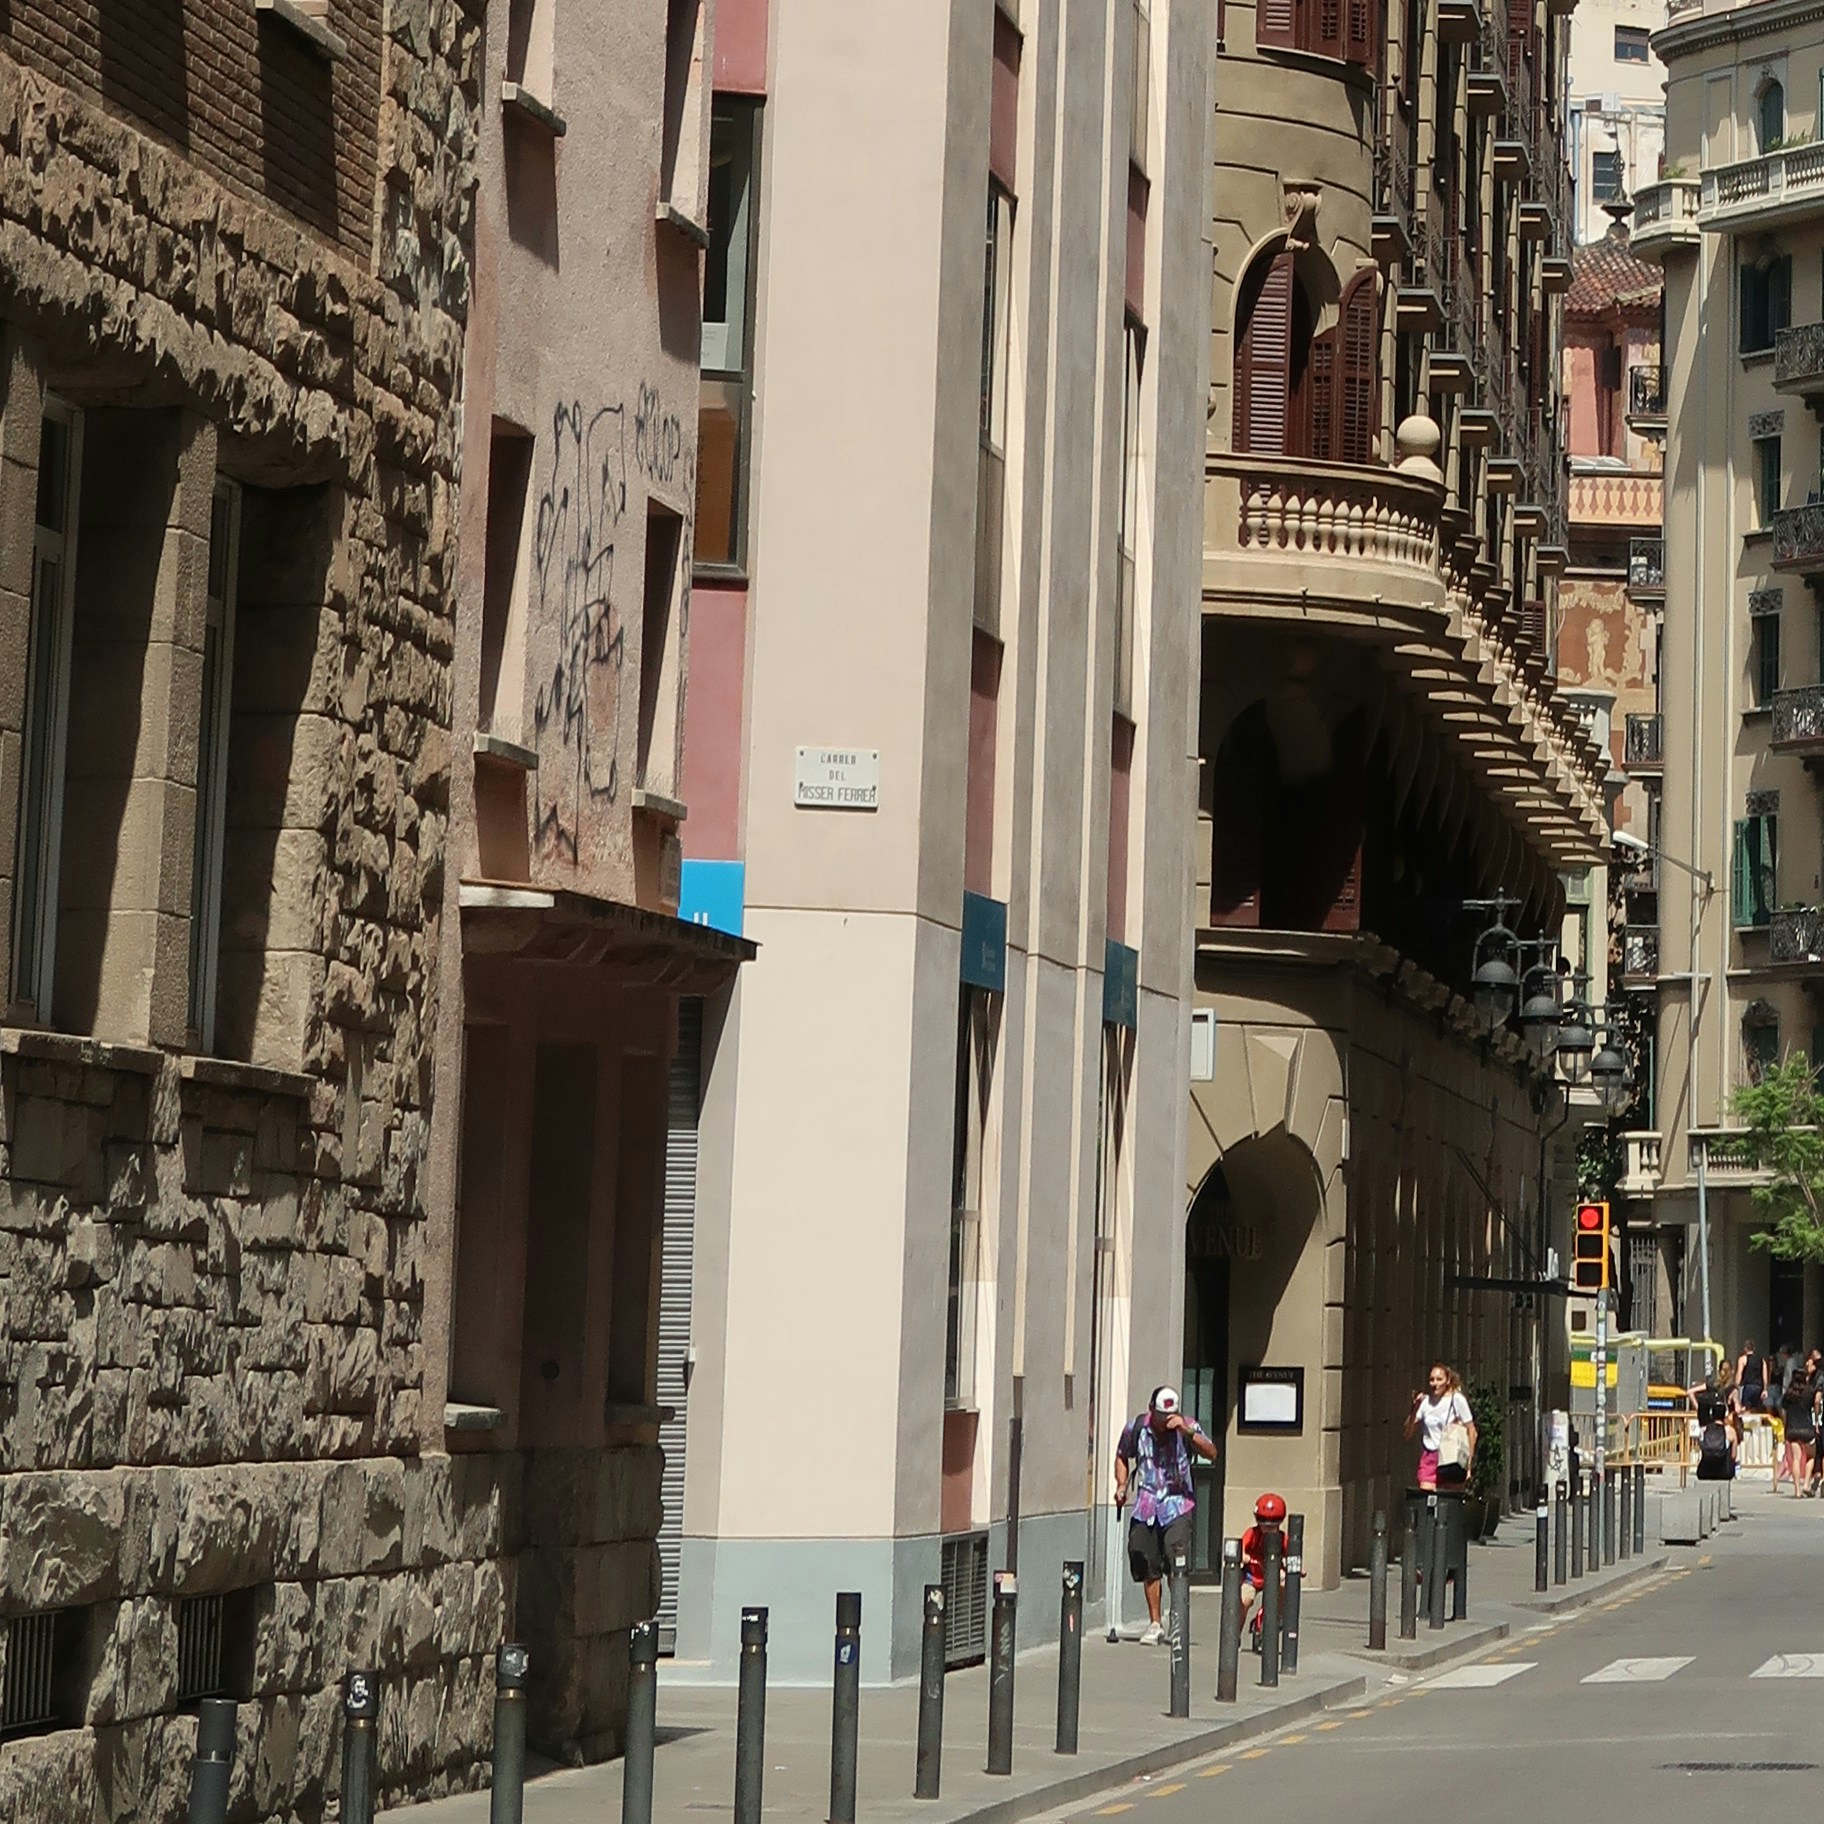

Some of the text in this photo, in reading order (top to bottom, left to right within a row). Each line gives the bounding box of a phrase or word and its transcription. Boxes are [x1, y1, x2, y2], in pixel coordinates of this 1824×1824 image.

[820, 754, 856, 765] CARRER
[829, 770, 847, 781] DEL
[798, 784, 876, 802] MISSER FERRER
